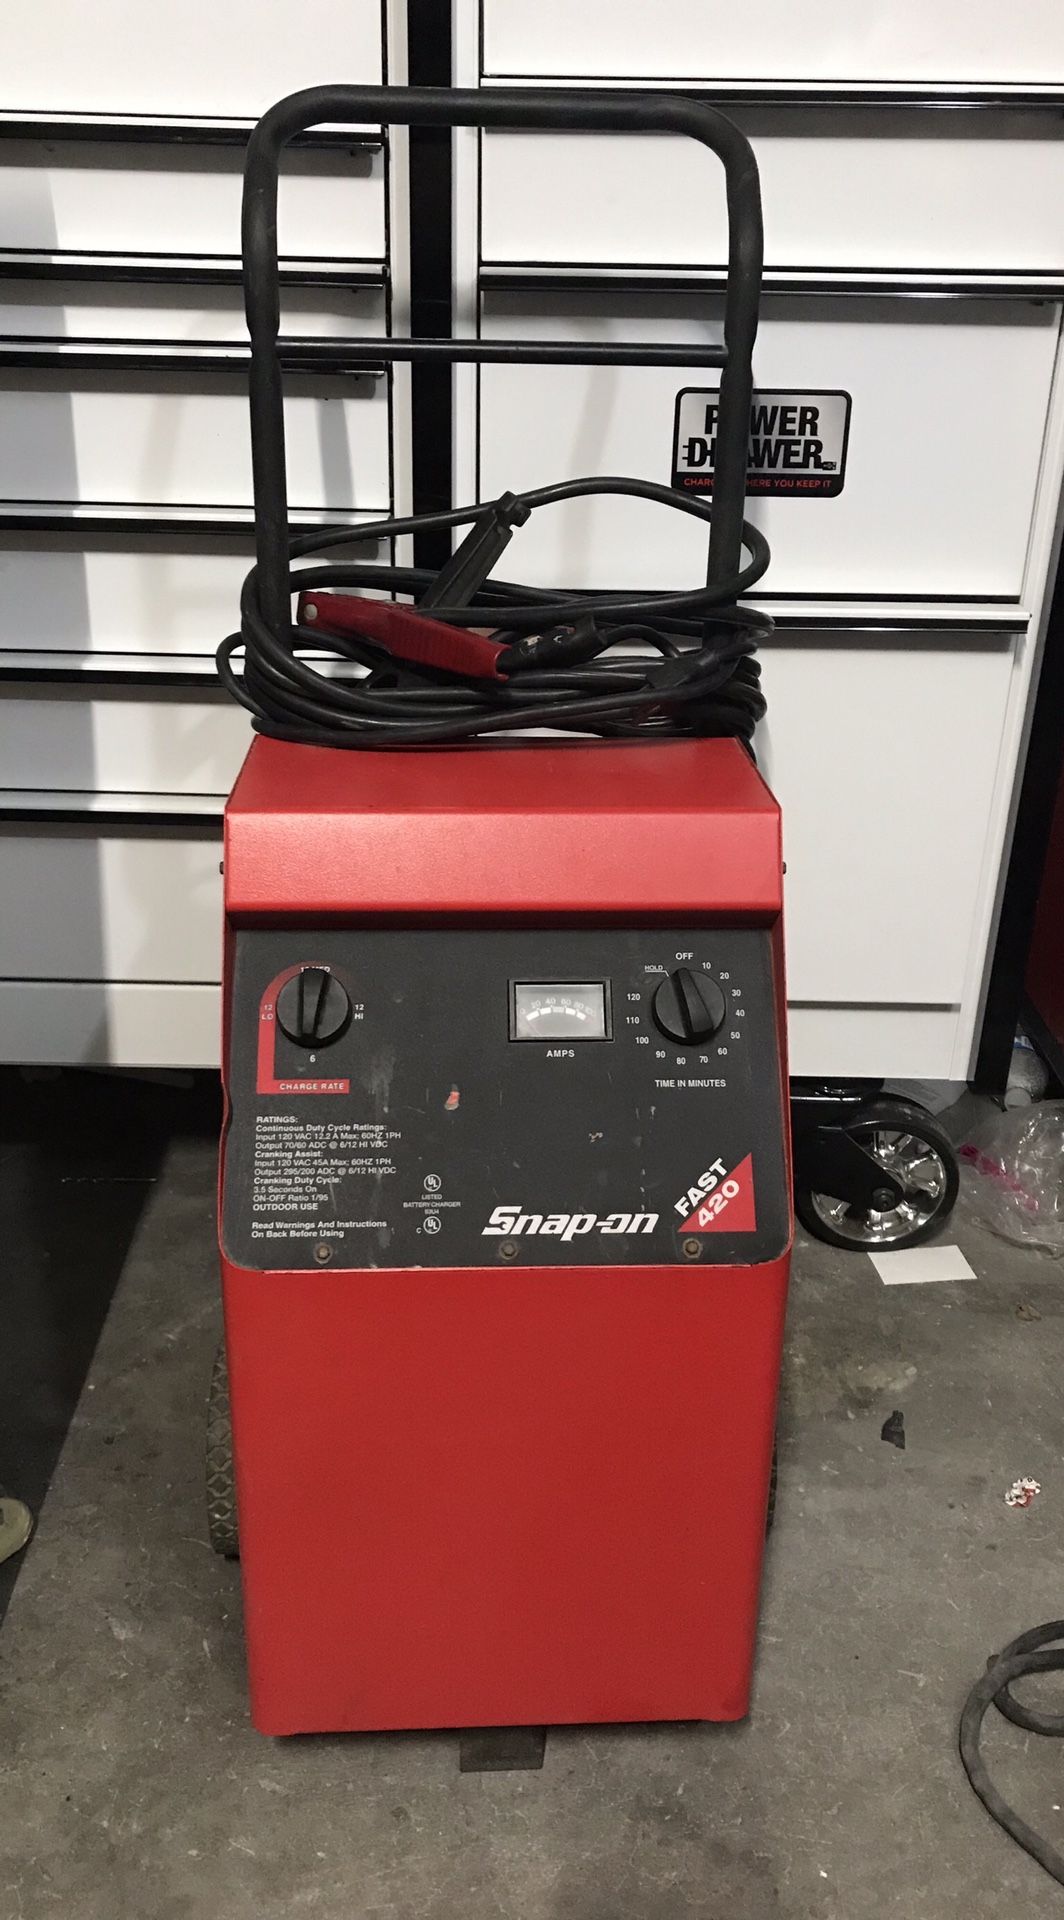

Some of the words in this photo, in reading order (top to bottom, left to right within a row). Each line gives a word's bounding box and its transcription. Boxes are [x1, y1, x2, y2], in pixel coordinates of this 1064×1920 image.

[704, 405, 819, 436] PWER
[746, 479, 771, 487] HERE
[774, 479, 794, 488] YOU
[797, 480, 821, 488] KEEP
[823, 480, 832, 488] IT
[675, 952, 694, 960] OFF
[720, 972, 729, 980] 20
[732, 989, 741, 997] 30
[735, 1009, 745, 1017] 40
[546, 1049, 575, 1058] AMPS
[676, 1057, 686, 1065] 80
[321, 1082, 344, 1090] RATE
[688, 1079, 726, 1087] MINUTES
[306, 1124, 325, 1133] Duty
[327, 1124, 350, 1132] Cycle
[353, 1123, 388, 1132] Ratings:
[255, 1133, 276, 1141] Input
[314, 1132, 331, 1140] 12.2
[385, 1131, 401, 1139] 1PH
[255, 1142, 282, 1150] Output
[329, 1141, 338, 1149] @
[370, 1140, 388, 1148] VDC
[255, 1151, 293, 1159] Cranking
[294, 1150, 324, 1158] Assist:
[254, 1159, 276, 1167] Input
[254, 1168, 282, 1176] Output
[317, 1167, 335, 1175] ADC
[337, 1167, 347, 1175] @
[378, 1166, 397, 1174] VDC
[253, 1177, 293, 1185] Cranking
[294, 1176, 314, 1185] Duty
[316, 1176, 342, 1184] Cycle:
[268, 1185, 303, 1193] Seconds
[305, 1185, 317, 1193] On
[673, 1157, 727, 1218] FAST
[288, 1194, 309, 1202] Ratio
[252, 1203, 298, 1211] OUTDOOR
[300, 1202, 319, 1210] USE
[697, 1179, 740, 1228] 420
[252, 1222, 274, 1230] Read
[275, 1221, 315, 1230] Warnings
[337, 1220, 387, 1228] Instructions
[481, 1205, 660, 1242] Snap-on
[251, 1230, 264, 1238] On
[266, 1230, 287, 1238] Back
[289, 1229, 317, 1237] Before
[319, 1229, 345, 1238] Using
